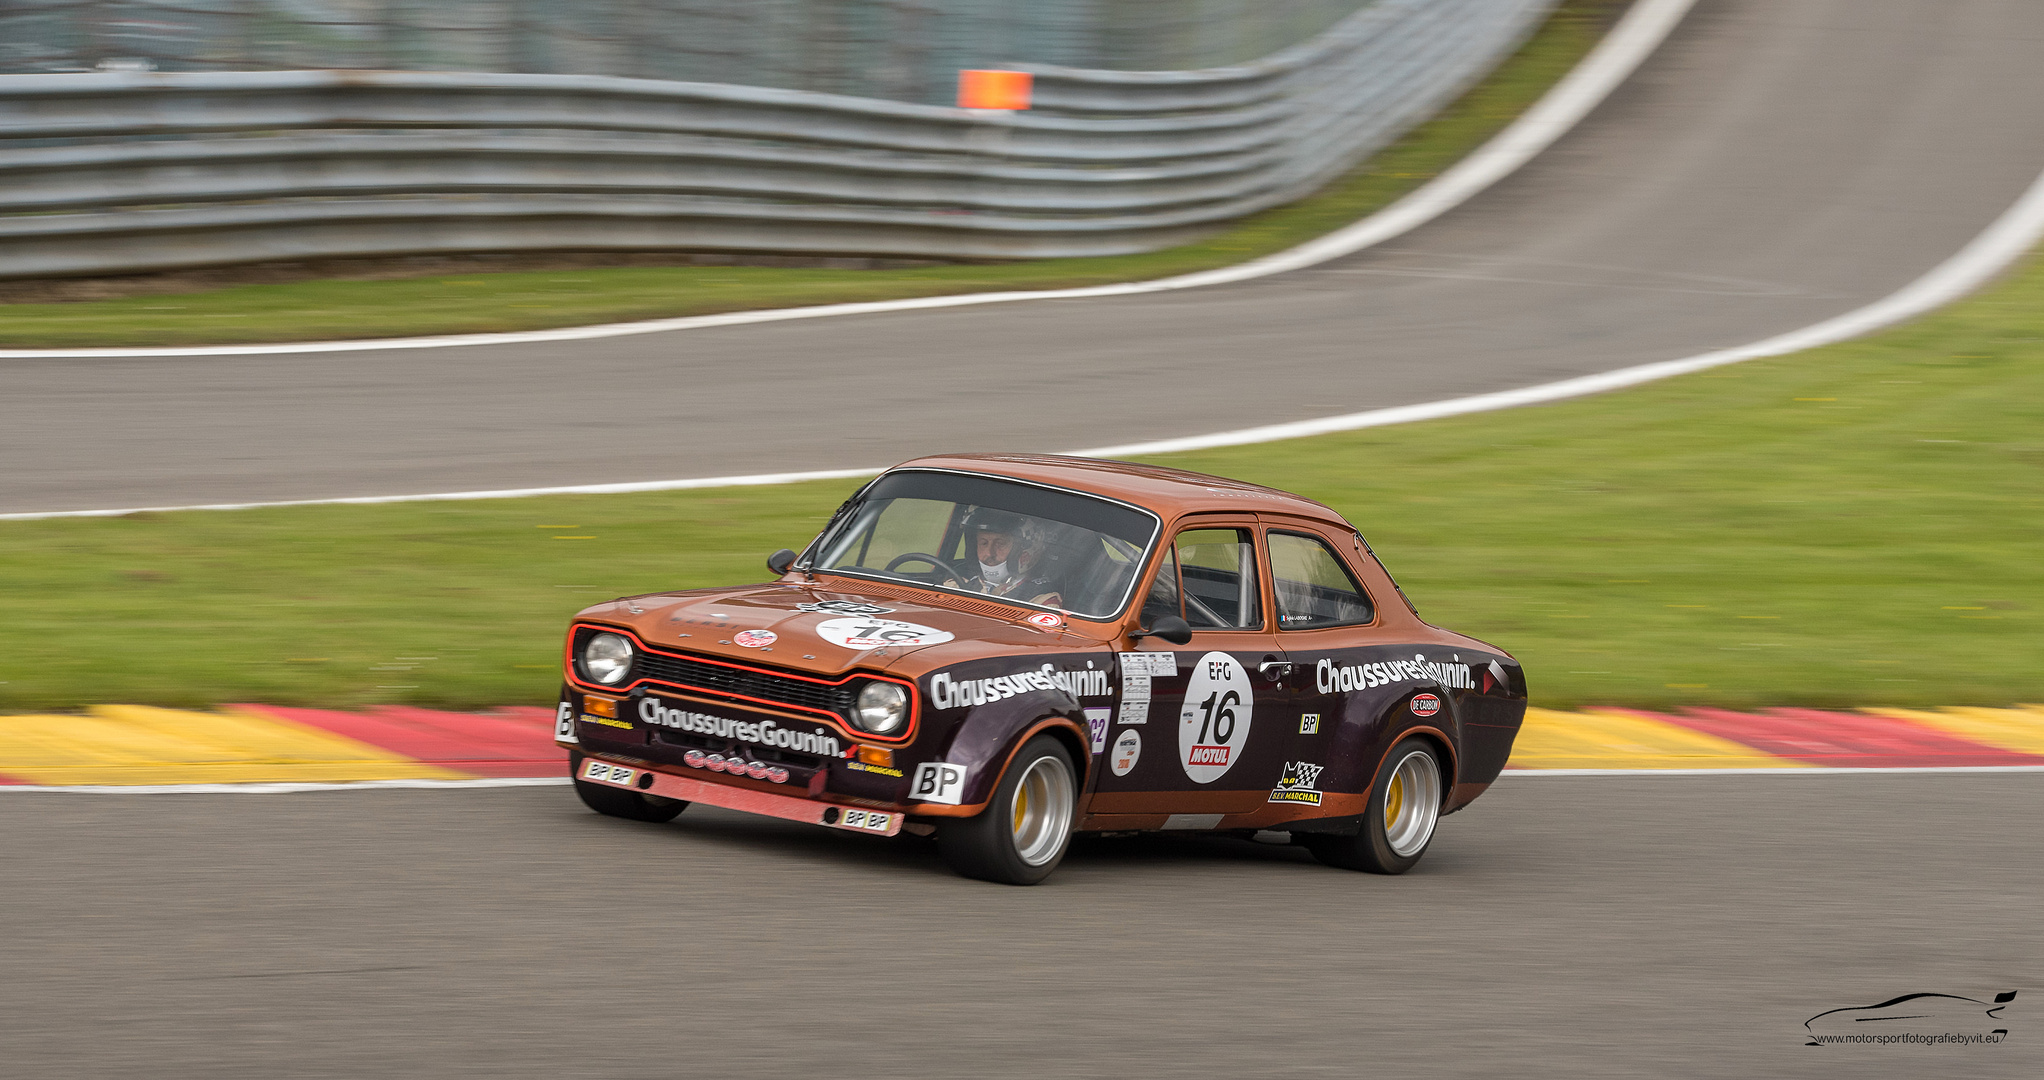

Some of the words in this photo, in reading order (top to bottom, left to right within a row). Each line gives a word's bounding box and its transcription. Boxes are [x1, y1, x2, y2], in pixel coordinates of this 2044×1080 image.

[853, 625, 926, 642] 16
[1208, 662, 1232, 681] EFG
[1316, 653, 1476, 696] ChaussuresGounin.
[931, 660, 1114, 711] ChaussuresGounin.
[1413, 700, 1420, 710] DE
[1197, 690, 1241, 745] 16
[1302, 716, 1316, 733] BP
[638, 697, 848, 759] ChaussuresGounin.
[1190, 747, 1229, 764] MOTUL
[589, 763, 611, 777] BP
[611, 768, 632, 782] BP
[917, 766, 959, 797] BP
[1285, 792, 1319, 802] MARCHAL
[846, 811, 866, 824] BP
[868, 814, 888, 828] BP
